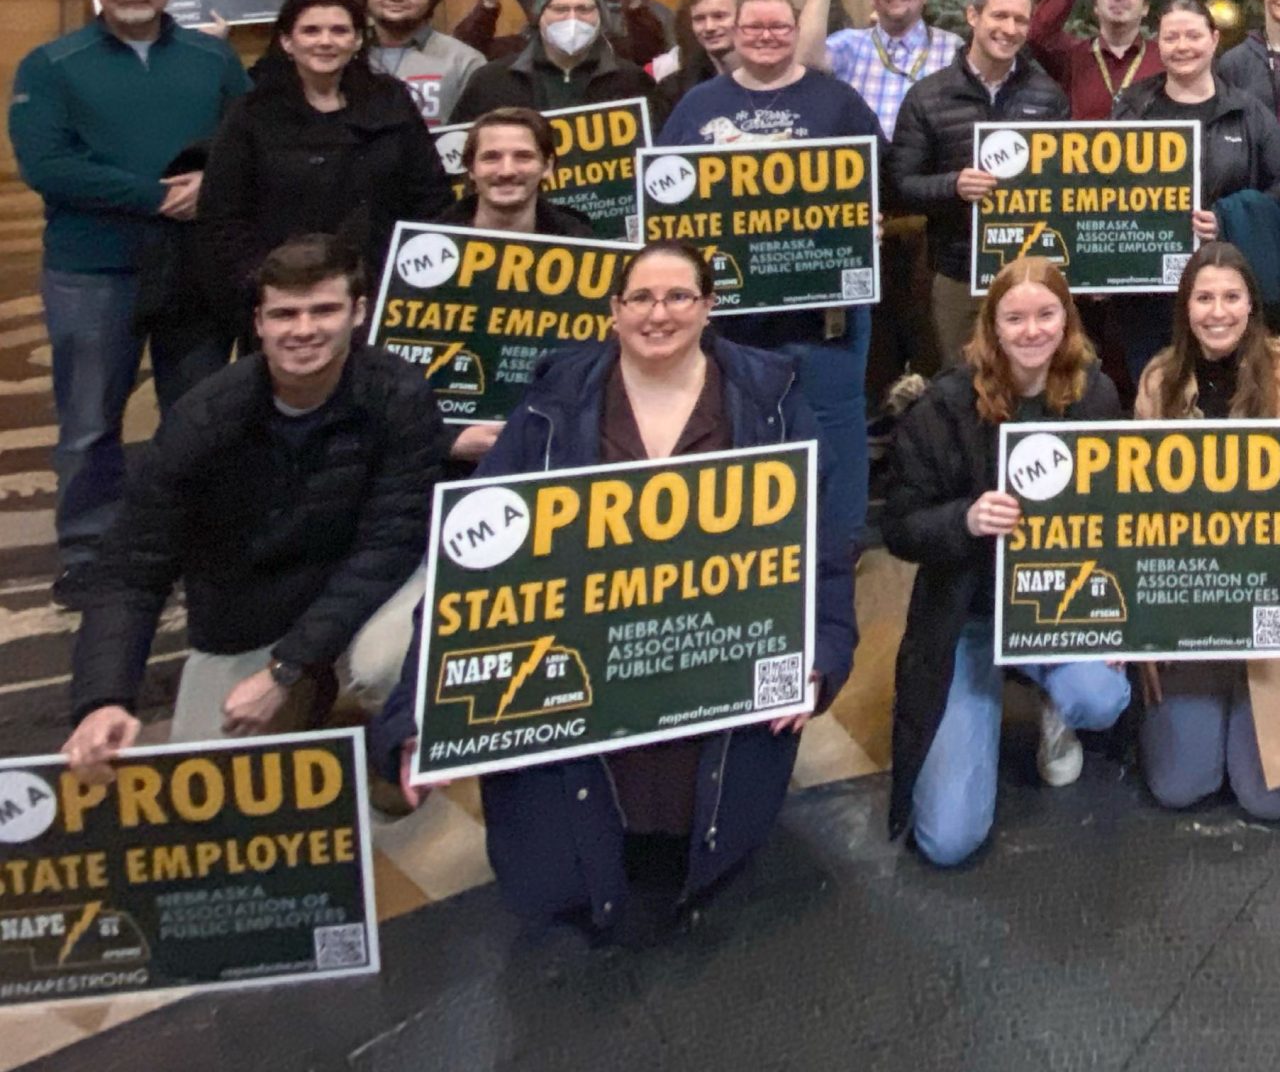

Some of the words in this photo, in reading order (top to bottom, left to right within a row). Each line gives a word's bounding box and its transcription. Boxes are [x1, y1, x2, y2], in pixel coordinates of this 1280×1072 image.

[550, 111, 637, 156] OUD
[984, 148, 1010, 170] I'M
[1013, 141, 1026, 155] A
[1031, 131, 1187, 174] PROUD
[648, 174, 676, 197] I'M
[679, 166, 693, 181] A
[699, 149, 864, 199] PROUD
[981, 189, 1052, 214] STATE
[1062, 186, 1191, 213] EMPLOYEE
[646, 212, 722, 241] STATE
[733, 202, 869, 235] EMPLOYEE
[987, 227, 1024, 243] NAPE
[1076, 220, 1139, 232] NEBRASKA
[1076, 230, 1155, 243] ASSOCIATION
[1158, 229, 1174, 241] OF
[400, 254, 434, 277] I'M
[440, 247, 456, 263] A
[1076, 243, 1115, 254] PUBLIC
[1118, 241, 1183, 253] EMPLOYEES
[458, 241, 631, 299] PROU
[384, 299, 478, 333] STATE
[487, 307, 613, 342] EMPLOY
[1013, 459, 1047, 488] I'M
[1052, 449, 1068, 468] A
[533, 460, 797, 556] PROUD
[449, 520, 495, 558] I'M
[504, 505, 524, 527] A
[1009, 515, 1103, 550] STATE
[1017, 569, 1066, 591] NAPE
[1136, 558, 1219, 574] NEBRASKA
[1136, 573, 1242, 590] ASSOCIATION
[1246, 571, 1267, 587] OF
[438, 578, 567, 636] STATE
[584, 544, 801, 614] EMPLOYEE
[1136, 590, 1188, 605] PUBLIC
[1193, 587, 1279, 604] EMPLOYEES
[607, 625, 742, 662] ASSOCIATION
[747, 618, 773, 638] OF
[608, 611, 714, 643] NEBRASKA
[1009, 631, 1123, 648] #NAPESTRONG
[445, 651, 513, 687] NAPE
[606, 654, 674, 681] PUBLIC
[680, 635, 787, 669] EMPLOYEES
[430, 717, 586, 760] #NAPESTRONG
[27, 787, 50, 807] A
[60, 748, 343, 833] PROUD
[125, 827, 355, 884] EMPLOYEE
